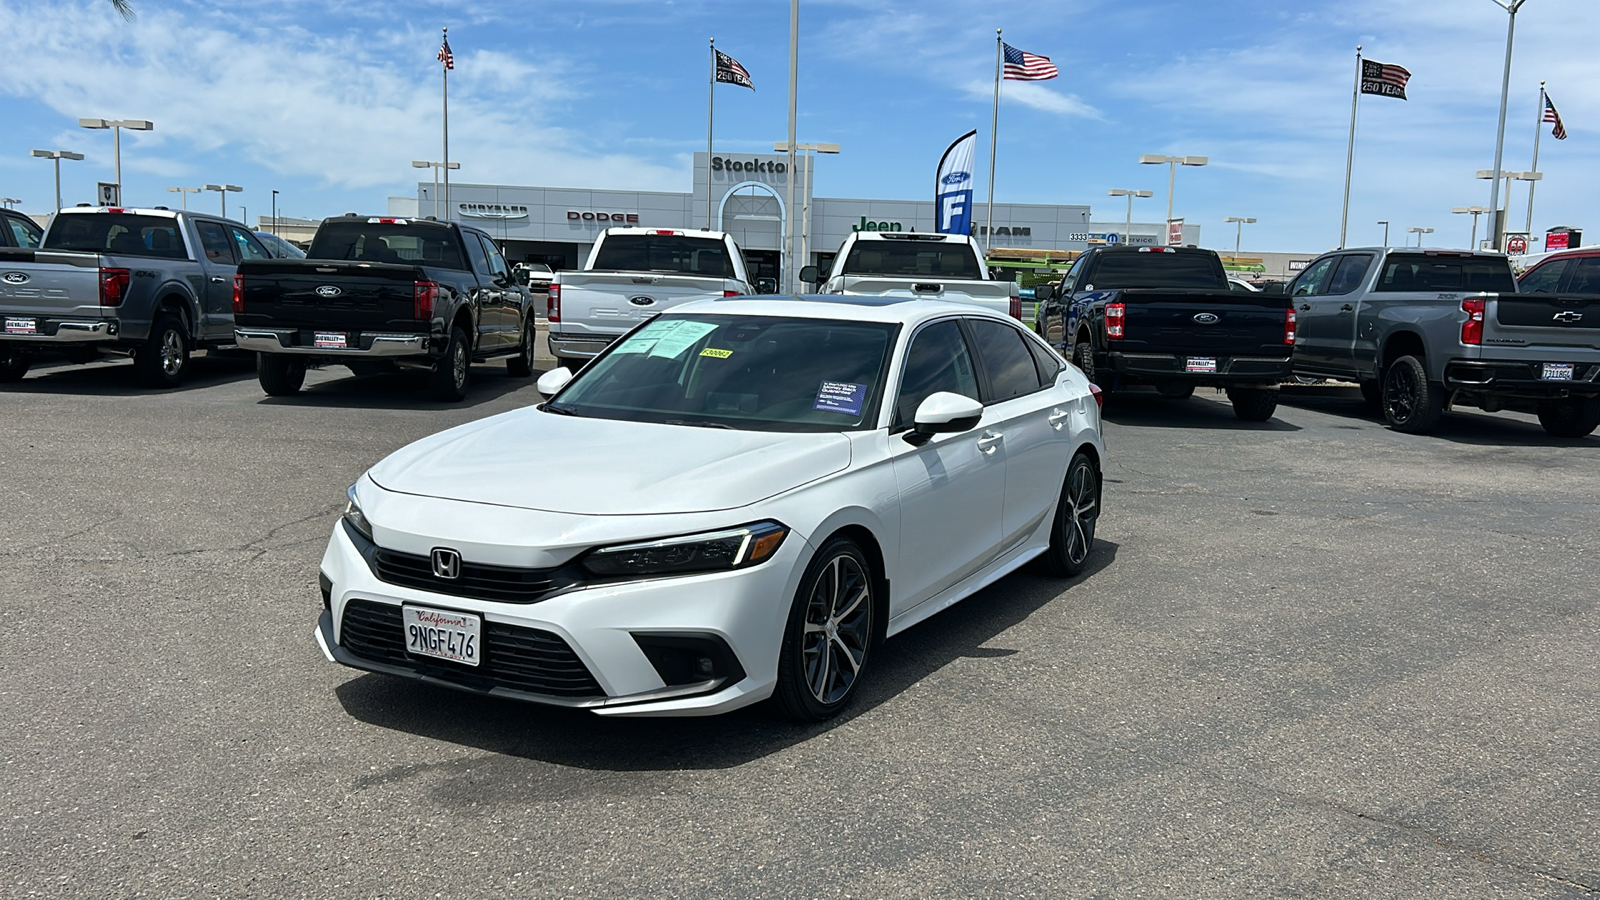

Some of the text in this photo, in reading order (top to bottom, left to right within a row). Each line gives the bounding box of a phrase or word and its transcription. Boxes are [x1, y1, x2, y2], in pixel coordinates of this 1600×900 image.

[718, 71, 732, 81] 250
[1363, 82, 1380, 92] 250
[459, 203, 528, 212] CHRYSLER
[942, 194, 966, 230] F
[567, 211, 639, 223] DODGE
[852, 216, 902, 232] Jeep
[980, 226, 1031, 236] RAM
[1070, 233, 1088, 241] 3333
[1510, 241, 1524, 252] 55
[419, 611, 464, 627] California
[409, 624, 475, 657] 9NGF476
